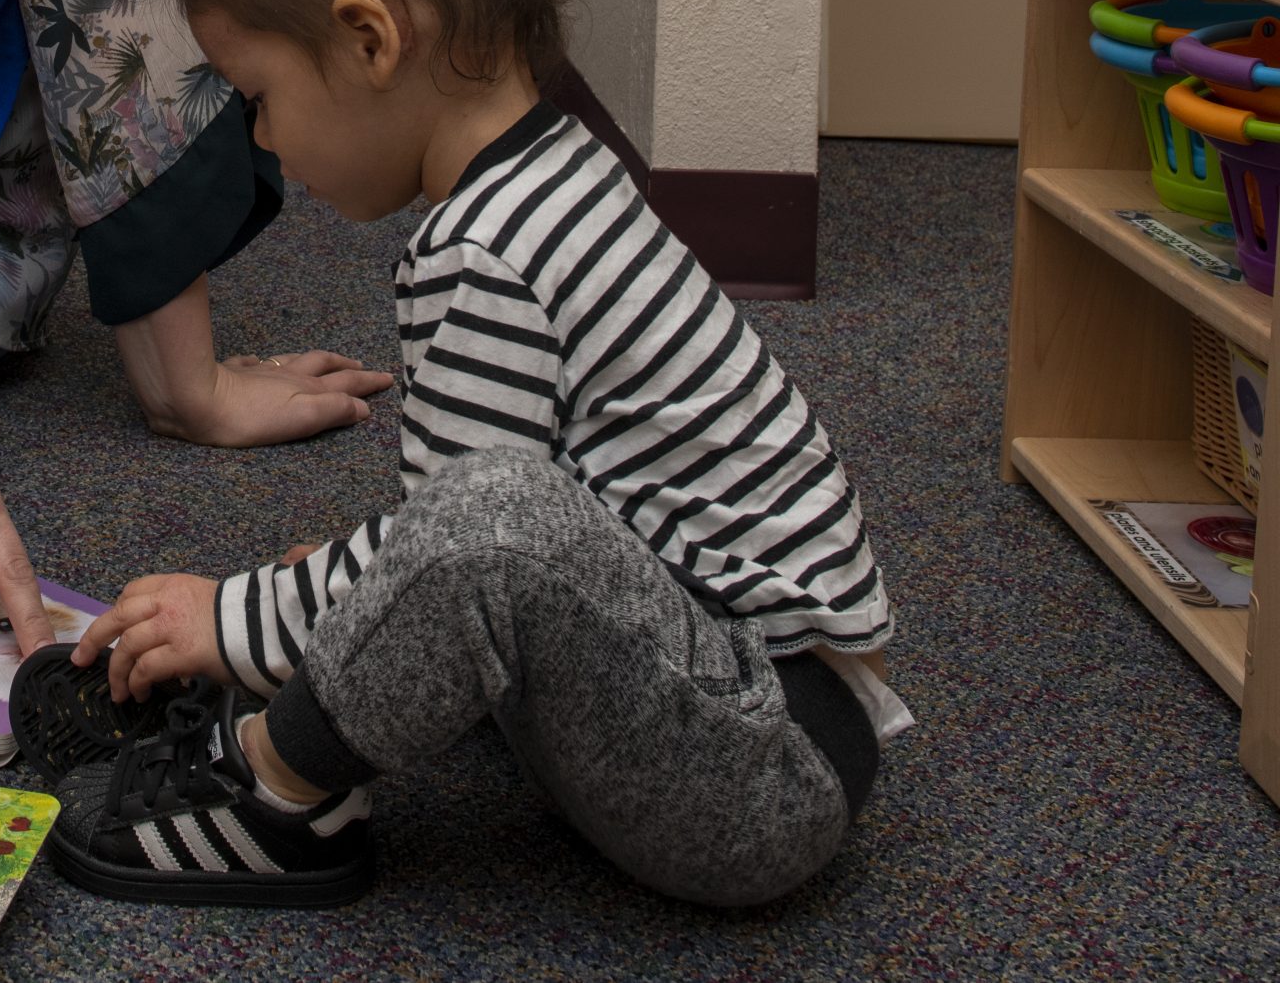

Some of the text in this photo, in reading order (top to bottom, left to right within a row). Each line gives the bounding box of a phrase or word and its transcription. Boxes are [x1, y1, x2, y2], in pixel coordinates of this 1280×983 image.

[1106, 513, 1187, 581] plates and utensils
